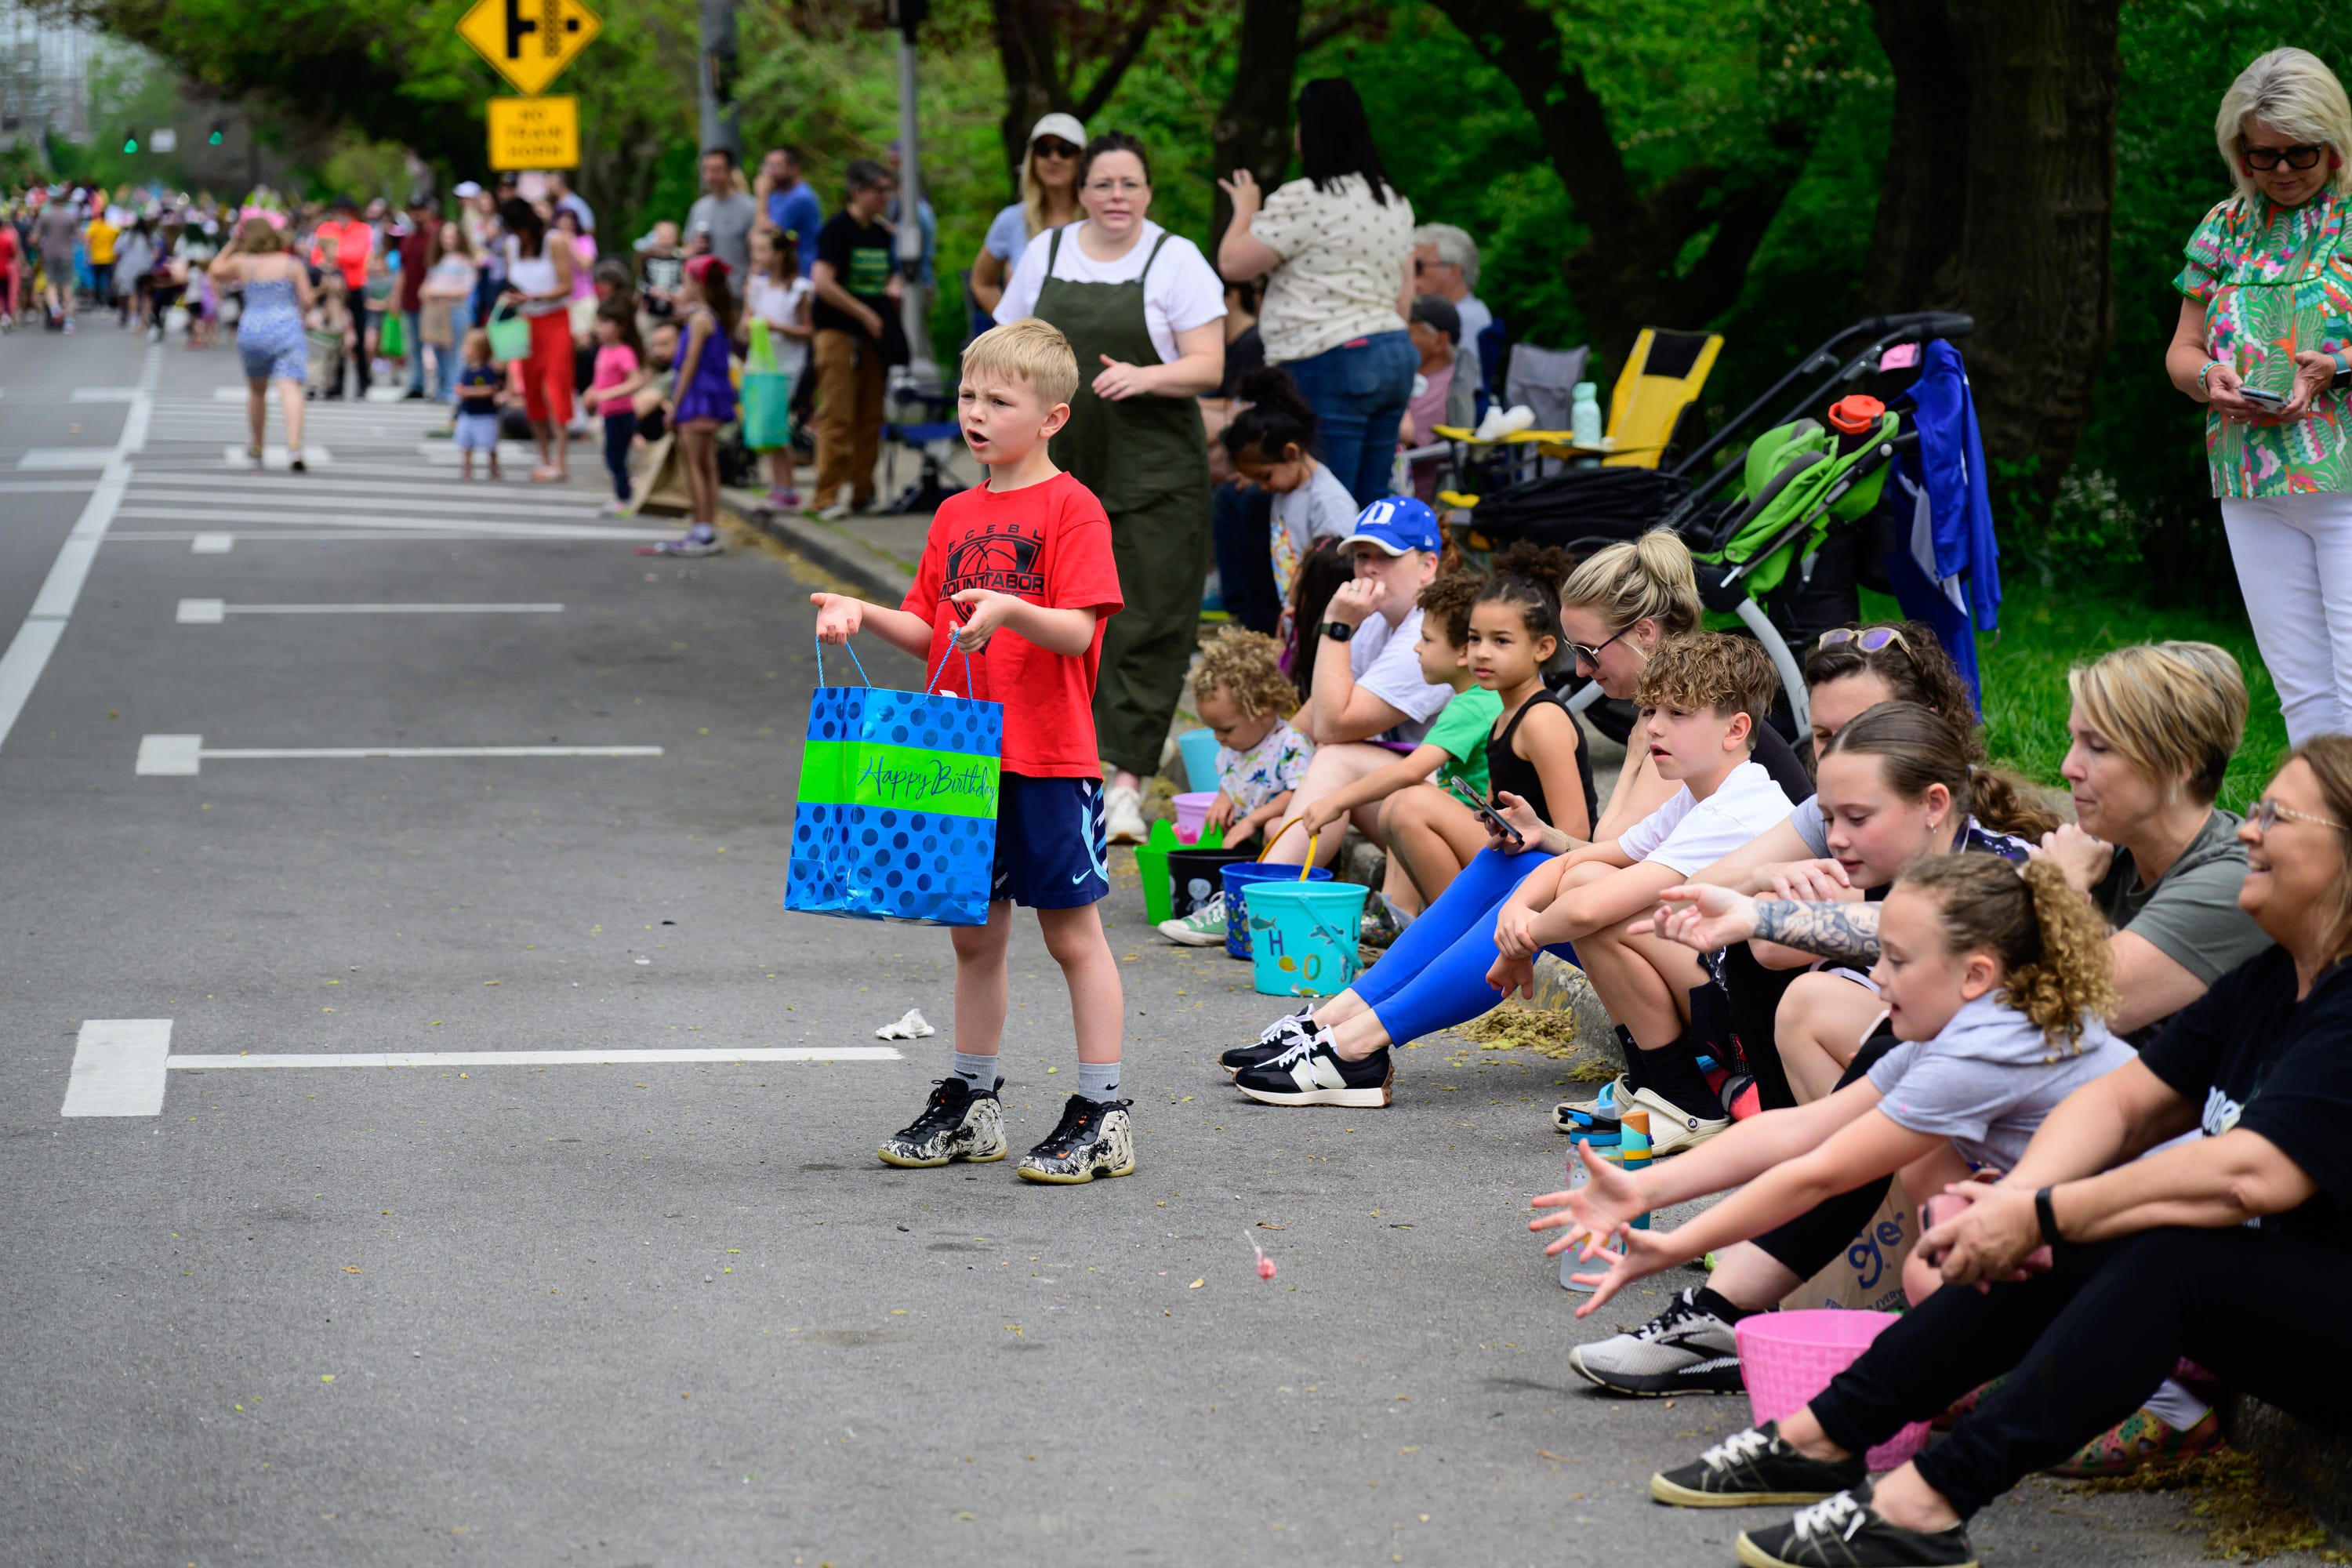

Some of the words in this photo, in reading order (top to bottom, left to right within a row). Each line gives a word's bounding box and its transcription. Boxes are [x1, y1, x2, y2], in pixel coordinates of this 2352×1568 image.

[985, 572, 1045, 593] TABOR
[858, 756, 931, 800] Happy
[930, 759, 1000, 819] Birthday
